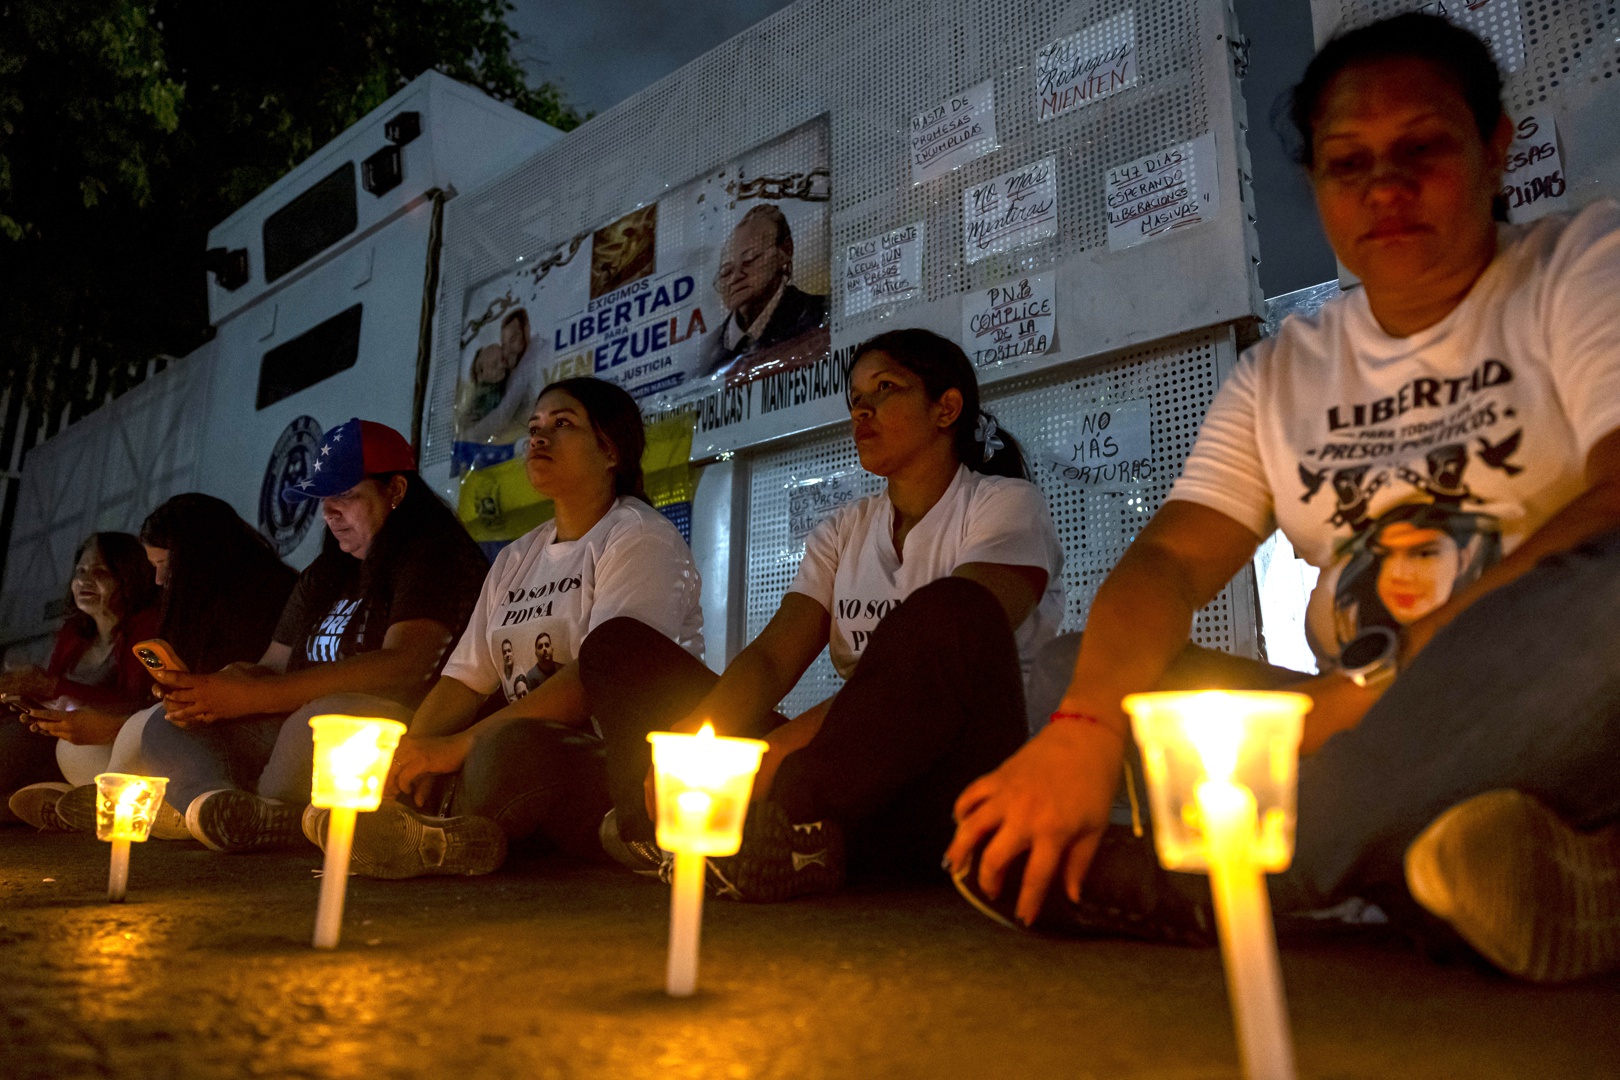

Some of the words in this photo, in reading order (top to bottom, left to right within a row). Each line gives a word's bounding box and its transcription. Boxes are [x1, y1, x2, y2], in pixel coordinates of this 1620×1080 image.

[1041, 61, 1128, 118] MIENTEN
[912, 106, 946, 132] BASTA
[951, 95, 969, 112] DE
[912, 115, 971, 149] PROMESAS
[915, 122, 982, 164] INCUMPLIDAS
[1107, 169, 1183, 206] ESPERANDO
[1110, 166, 1141, 185] 147
[849, 241, 876, 260] DELCY
[882, 227, 917, 249] MIENTE
[864, 265, 898, 286] PRESOS
[587, 279, 650, 313] EXIGIMOS
[987, 279, 1031, 306] PNB
[554, 275, 695, 351] LIBERTAD
[603, 325, 629, 341] PARA
[990, 326, 1012, 341] DE
[1018, 319, 1035, 335] LA
[542, 308, 707, 386] VENEZUELA
[972, 334, 1047, 366] TORTURA
[621, 356, 672, 382] JUSTICIA
[761, 345, 856, 415] MANIFESTACION
[1081, 411, 1111, 435] NO
[1049, 458, 1152, 484] TORTURAS
[789, 499, 809, 513] LOS
[813, 490, 854, 507] PRESOS
[500, 588, 526, 606] NO
[836, 599, 861, 619] NO
[500, 600, 553, 627] PDVSA
